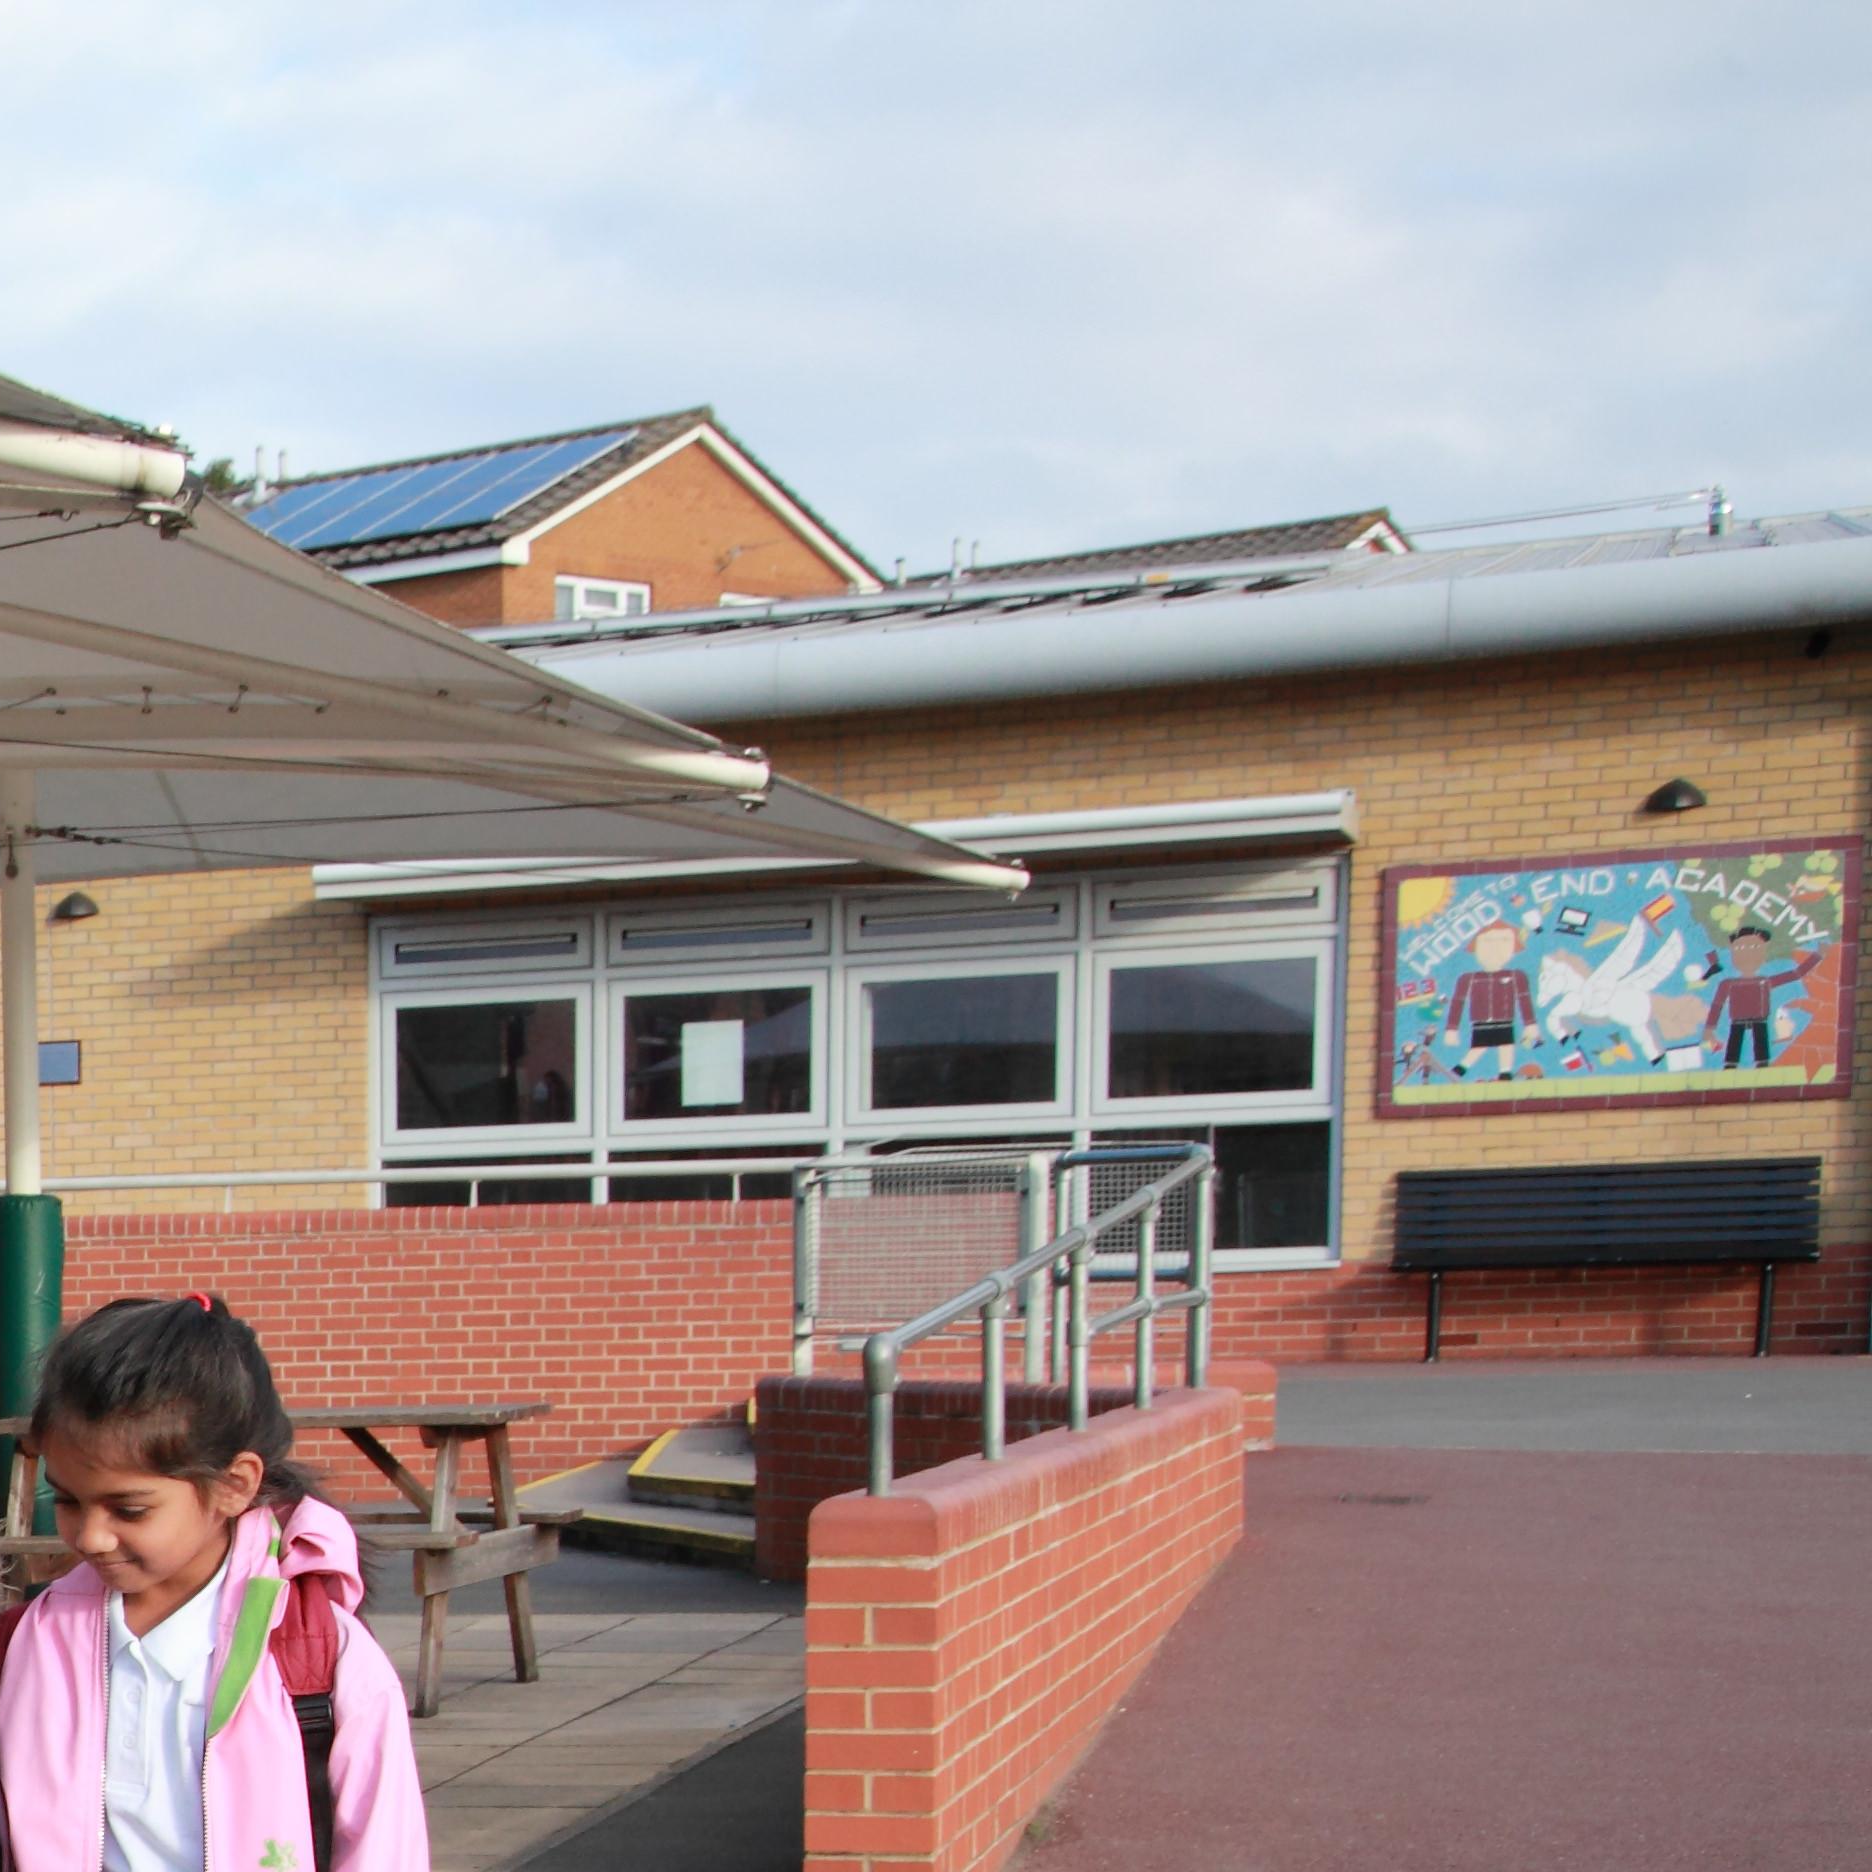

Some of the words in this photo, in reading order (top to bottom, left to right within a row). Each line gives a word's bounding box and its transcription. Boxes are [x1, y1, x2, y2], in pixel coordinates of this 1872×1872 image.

[1409, 900, 1502, 976] WOOD
[1531, 867, 1616, 903] END
[1645, 867, 1830, 943] ACADEMY
